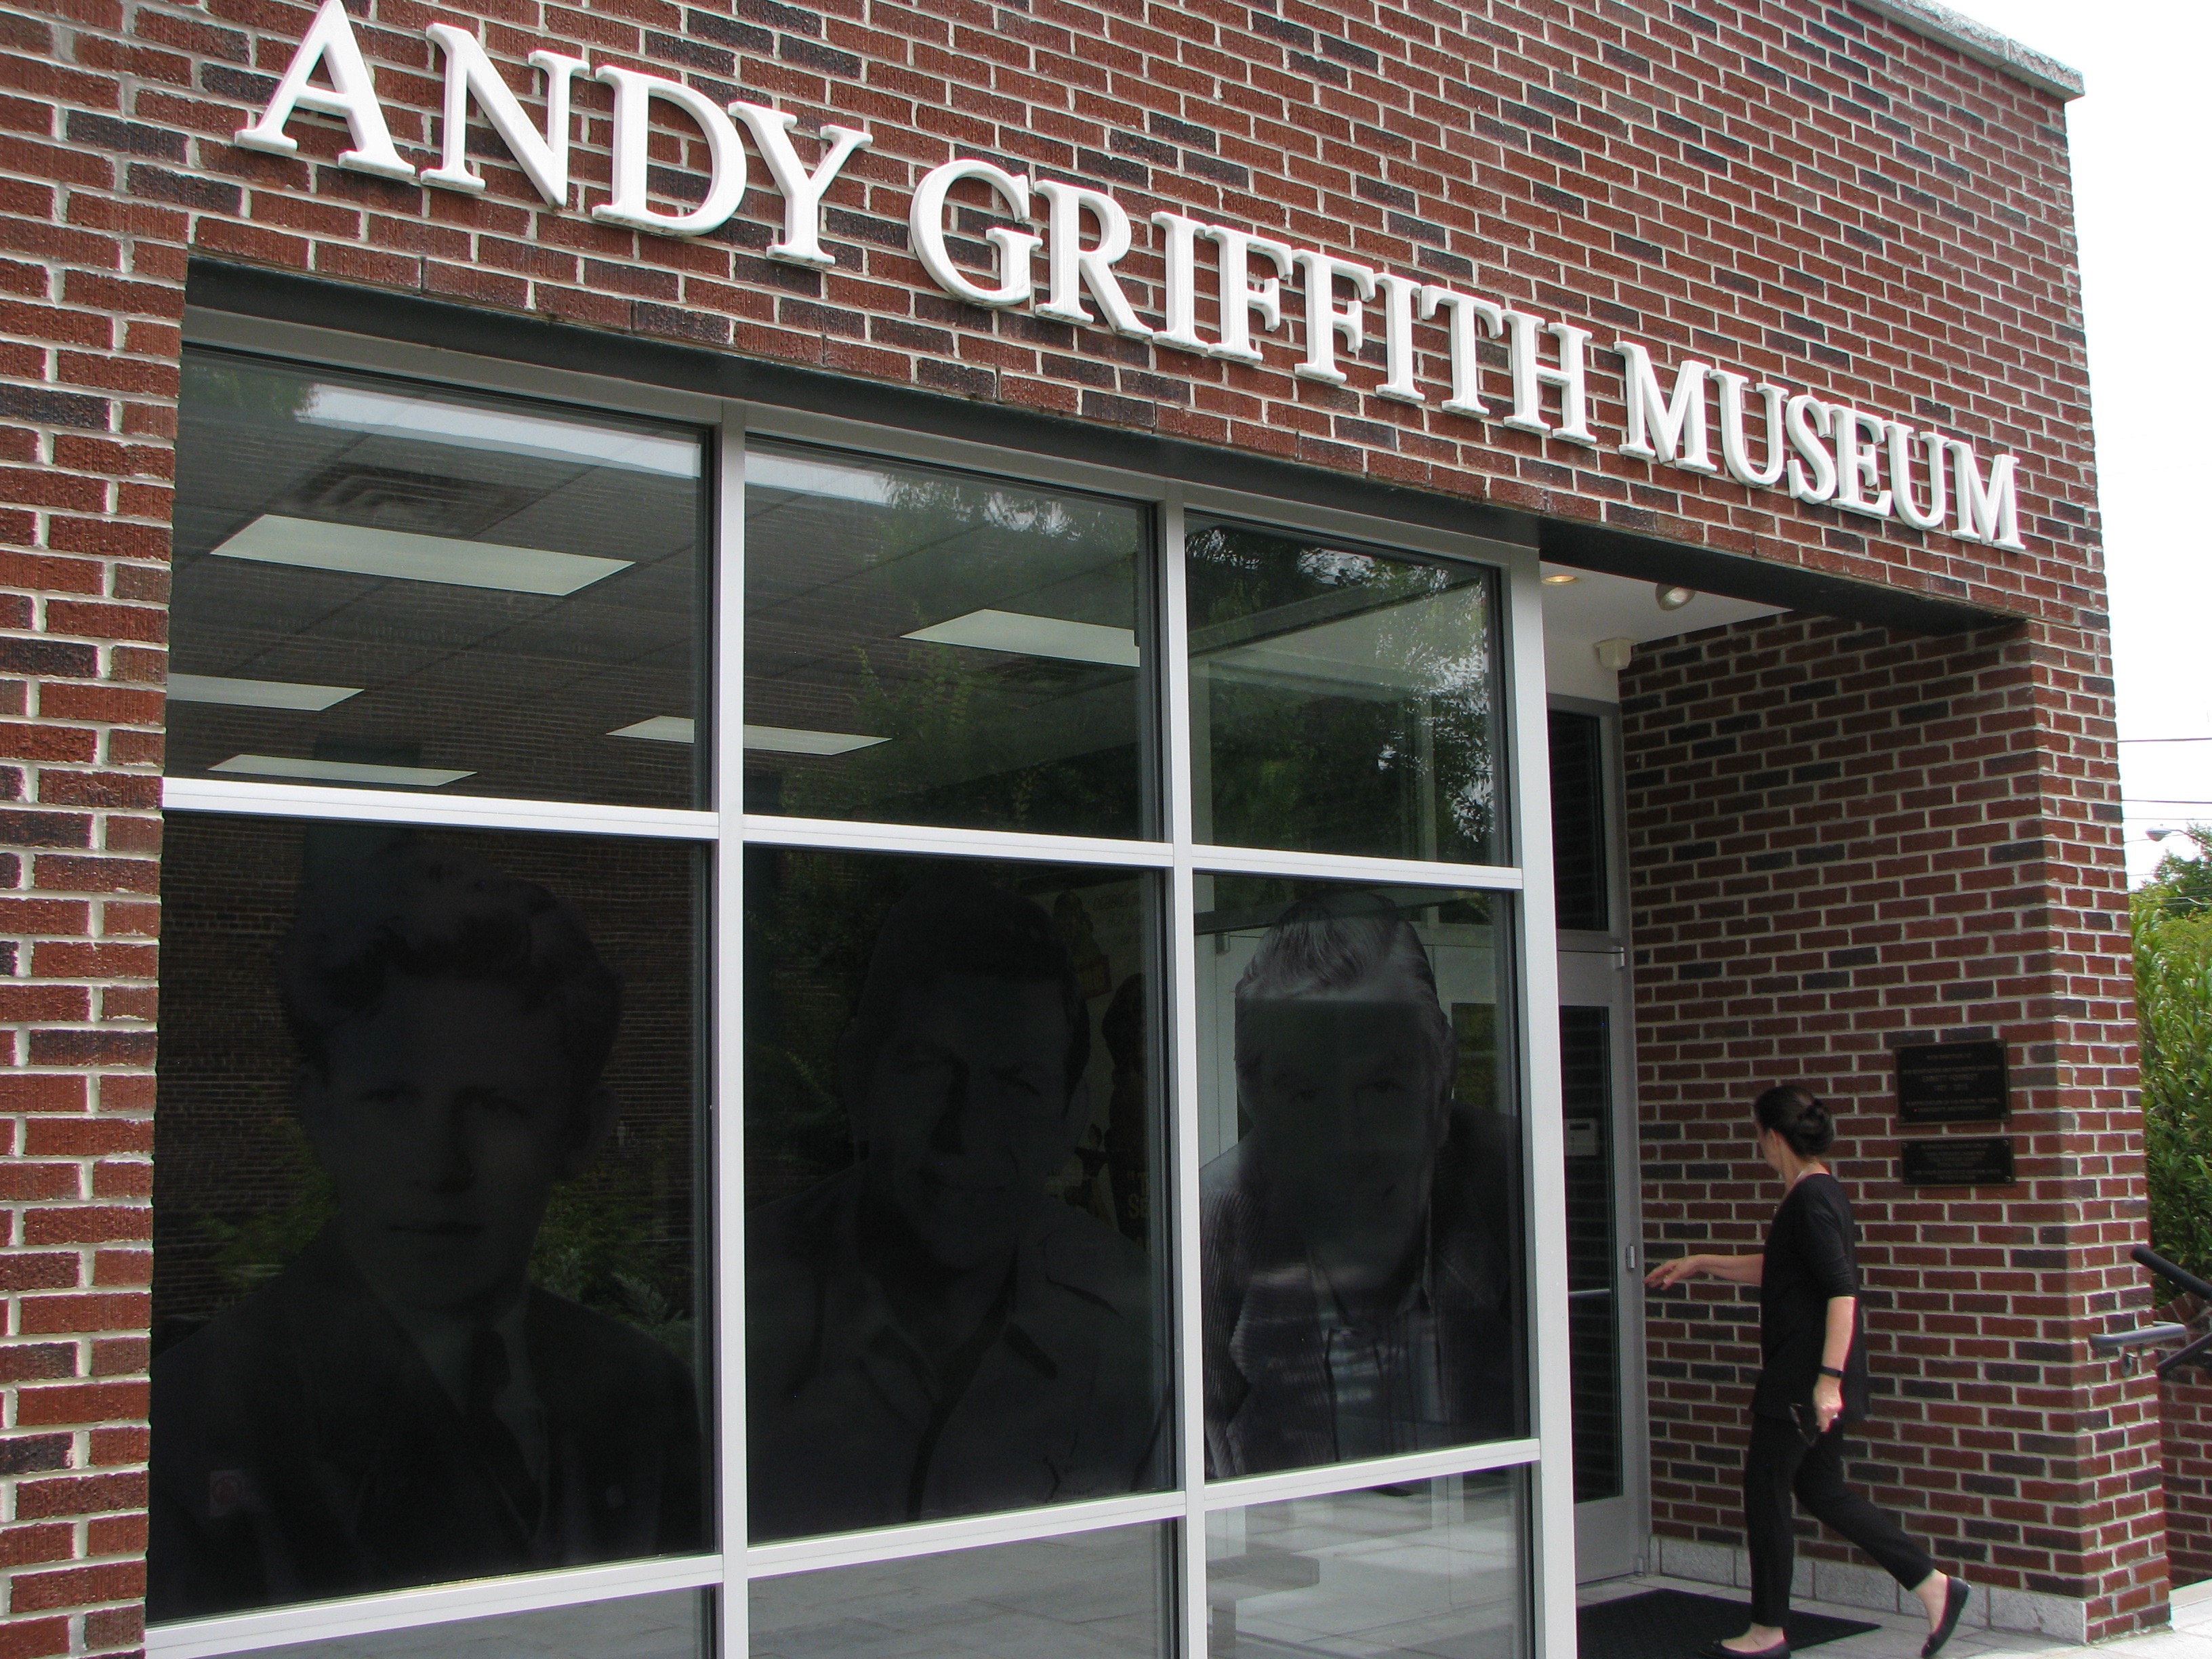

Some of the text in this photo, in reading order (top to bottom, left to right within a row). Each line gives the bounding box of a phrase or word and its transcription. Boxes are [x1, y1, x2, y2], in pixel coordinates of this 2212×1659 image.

[235, 0, 2026, 552] ANDY GRIFFITH MUSEUM
